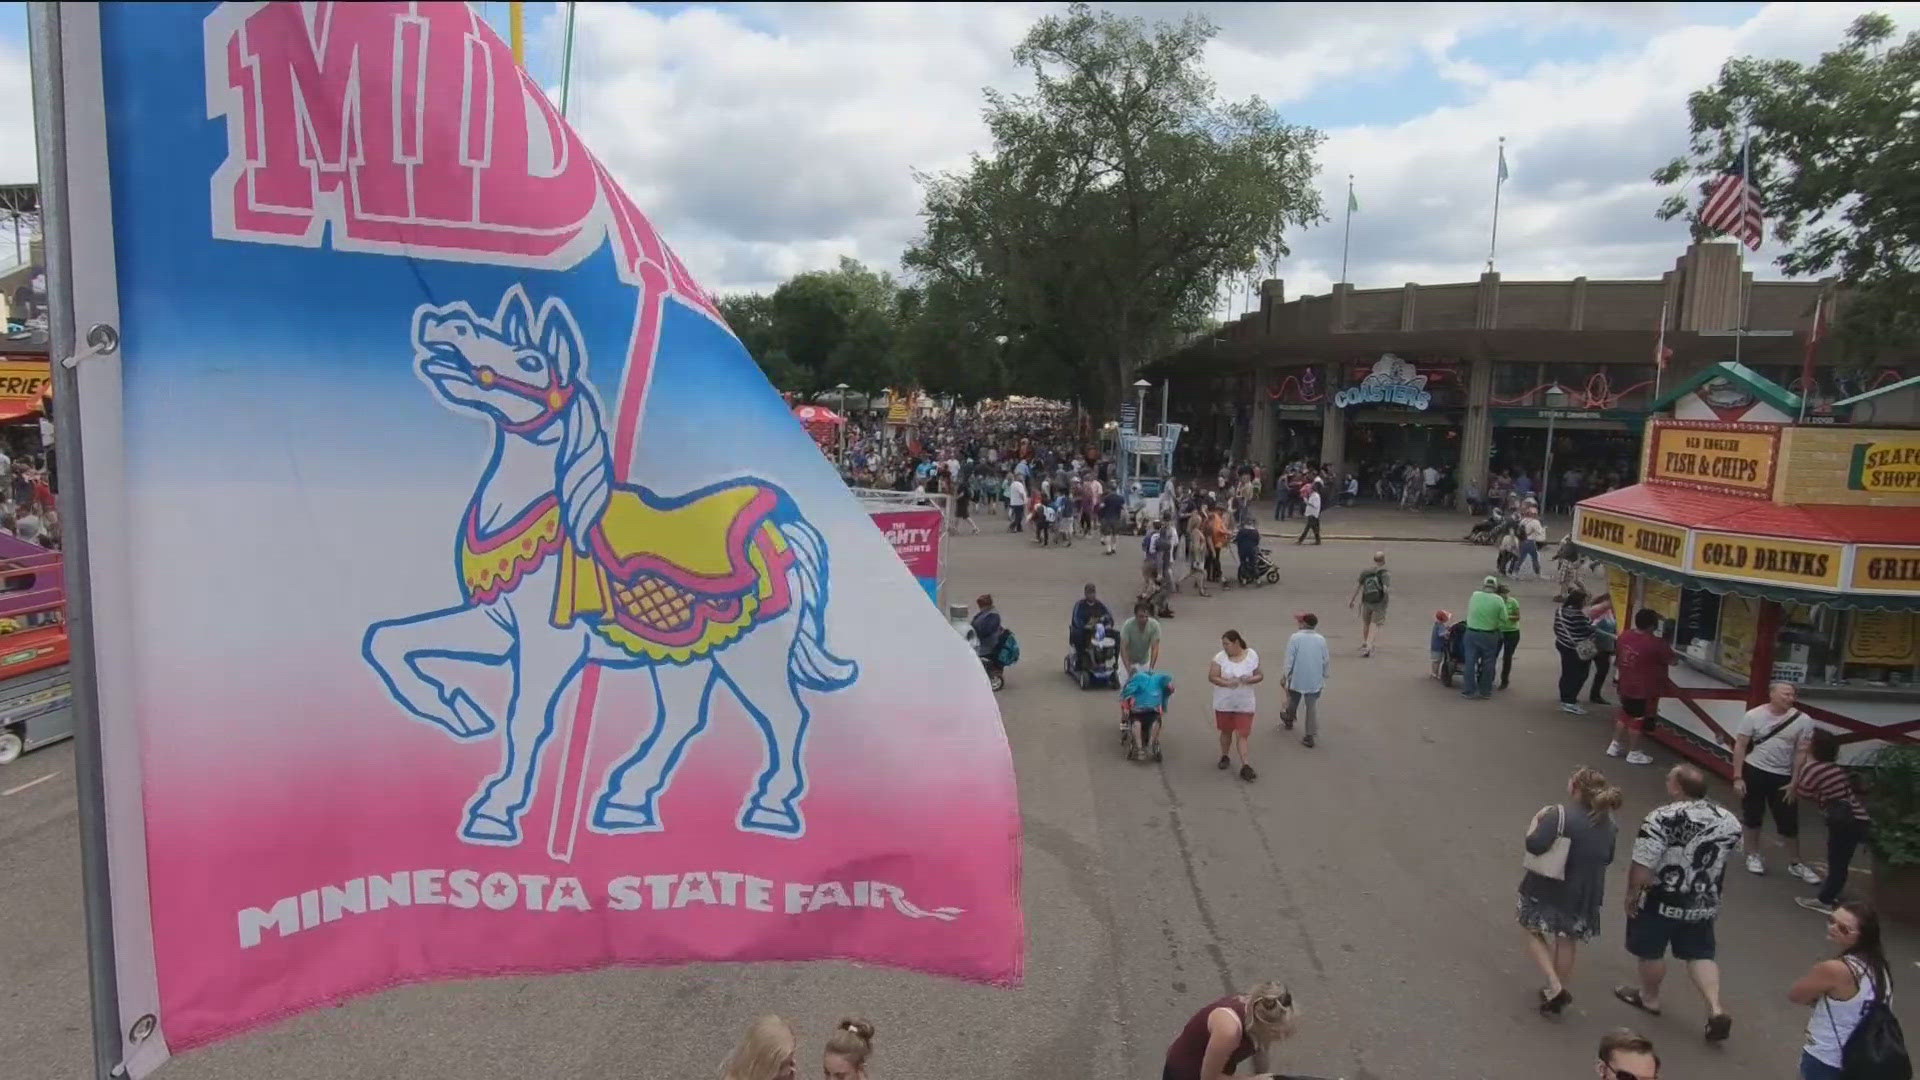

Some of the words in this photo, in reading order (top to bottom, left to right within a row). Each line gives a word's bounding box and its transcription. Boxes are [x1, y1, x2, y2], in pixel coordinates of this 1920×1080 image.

[203, 0, 612, 266] MID
[1335, 384, 1432, 411] COASTERS
[1685, 437, 1700, 449] OLD
[1703, 438, 1741, 453] ENGLISH
[1665, 452, 1697, 476] FISH
[1699, 455, 1710, 477] &
[1712, 456, 1759, 482] CHIPS
[892, 522, 906, 530] THE
[1581, 516, 1625, 546] LOBSTER
[1635, 528, 1682, 559] SHRIMP
[1702, 542, 1748, 569] COLD
[1753, 547, 1830, 578] DRINKS
[238, 868, 592, 949] MINNESOTA
[607, 871, 774, 912] STATE
[784, 880, 967, 921] FAIR
[1659, 902, 1684, 919] LED
